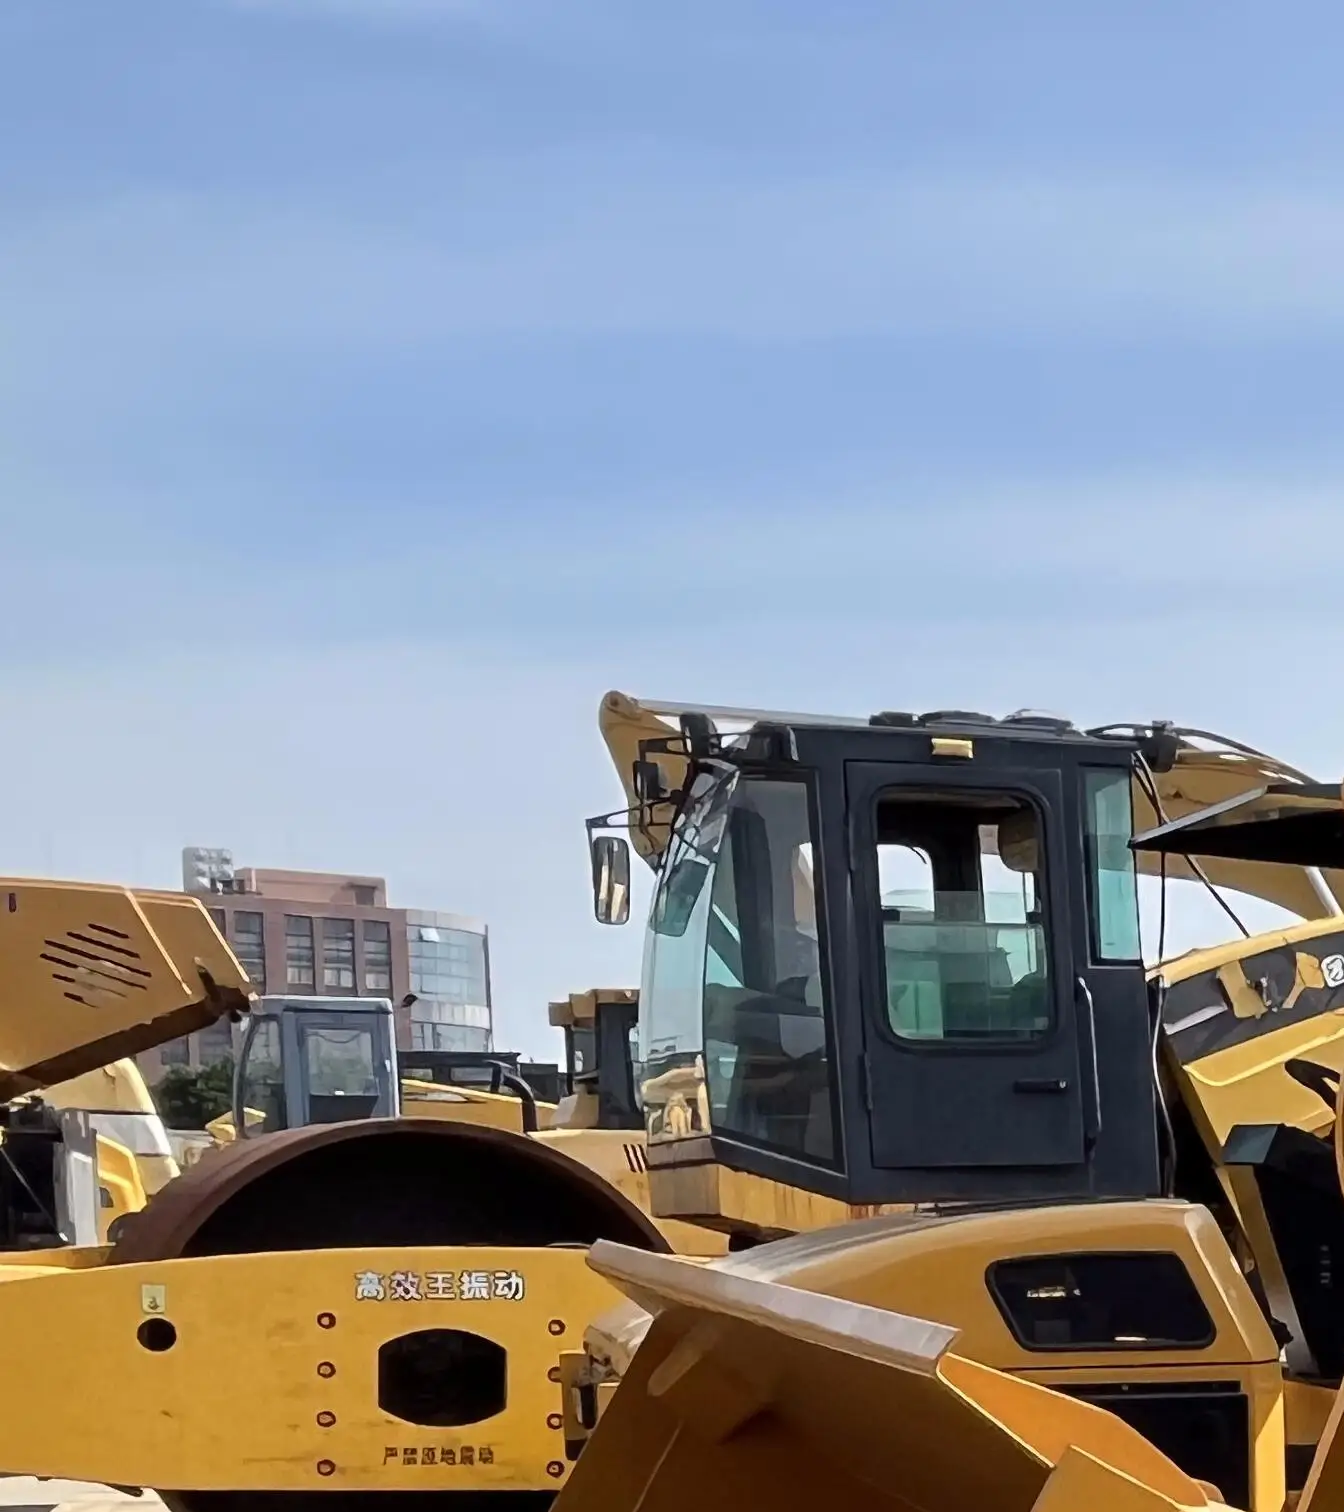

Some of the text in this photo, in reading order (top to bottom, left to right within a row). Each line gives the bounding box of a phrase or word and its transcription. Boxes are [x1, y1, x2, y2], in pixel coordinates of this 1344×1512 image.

[355, 1270, 525, 1301] 高效王振动
